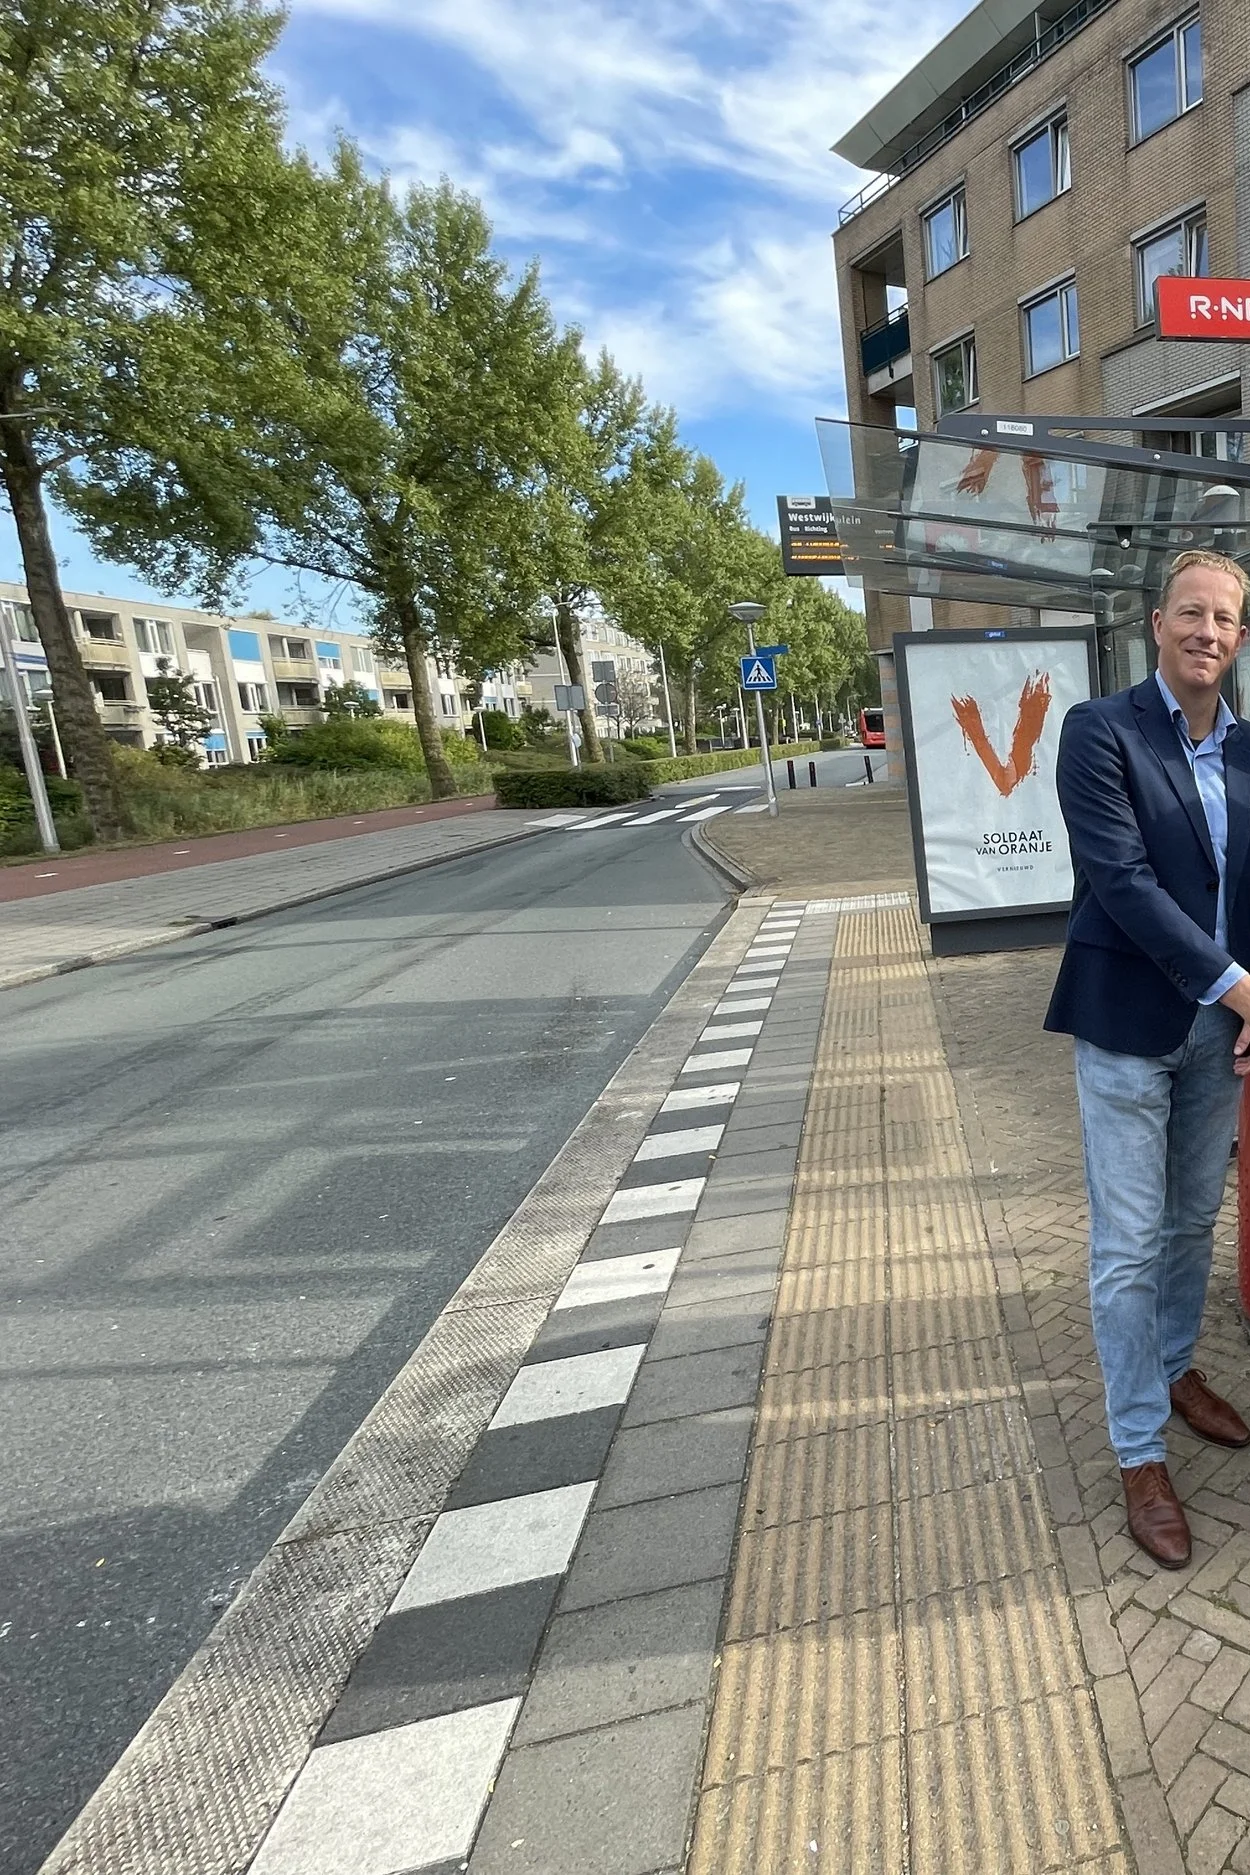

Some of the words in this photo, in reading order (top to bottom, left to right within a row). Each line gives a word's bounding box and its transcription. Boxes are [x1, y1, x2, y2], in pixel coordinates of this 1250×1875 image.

[983, 830, 1043, 845] SOLDAAT
[975, 847, 996, 855] VAN
[998, 841, 1052, 855] ORANJE
[997, 864, 1034, 872] VERNIEUWD
